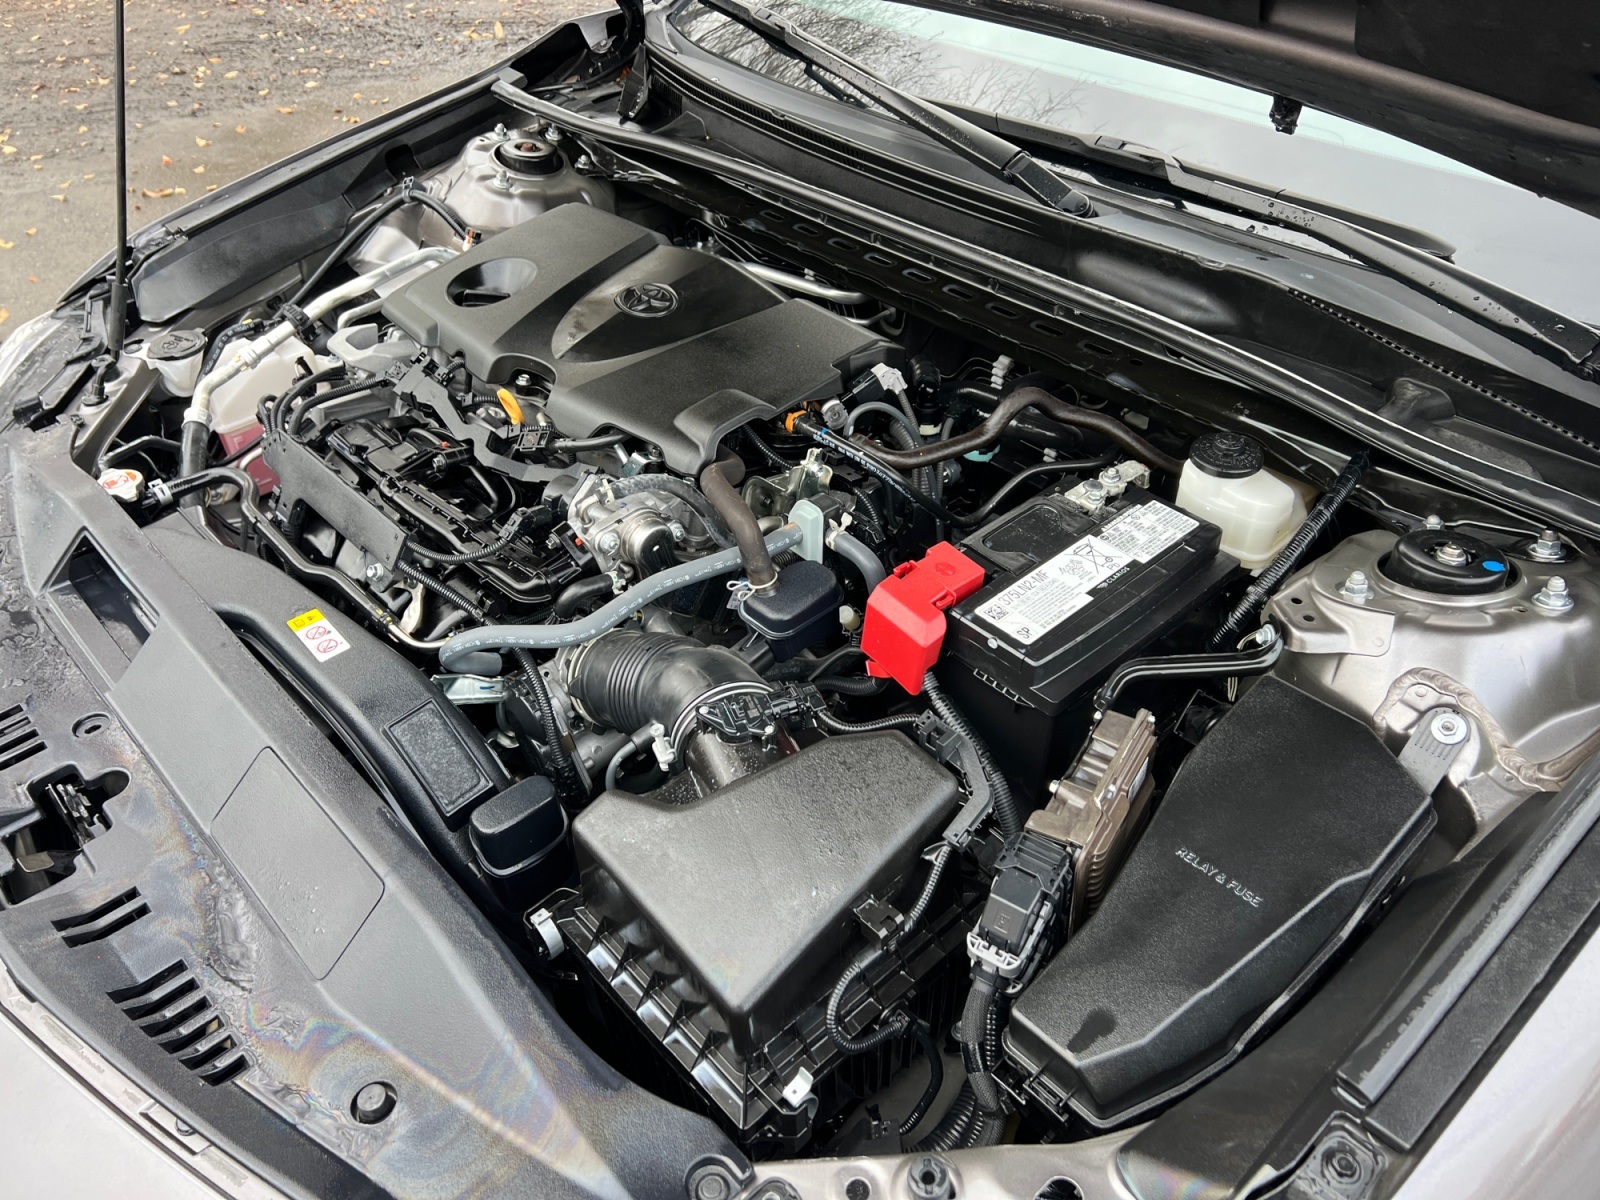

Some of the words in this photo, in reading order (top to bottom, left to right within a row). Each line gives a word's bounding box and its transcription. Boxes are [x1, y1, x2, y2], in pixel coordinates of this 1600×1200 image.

[998, 569, 1050, 606] 375LN2-MF
[1105, 566, 1131, 584] CLARIOS
[1016, 626, 1034, 639] SP
[1175, 846, 1219, 876] RELAY
[1215, 873, 1227, 884] &
[1226, 880, 1263, 907] FUSE
